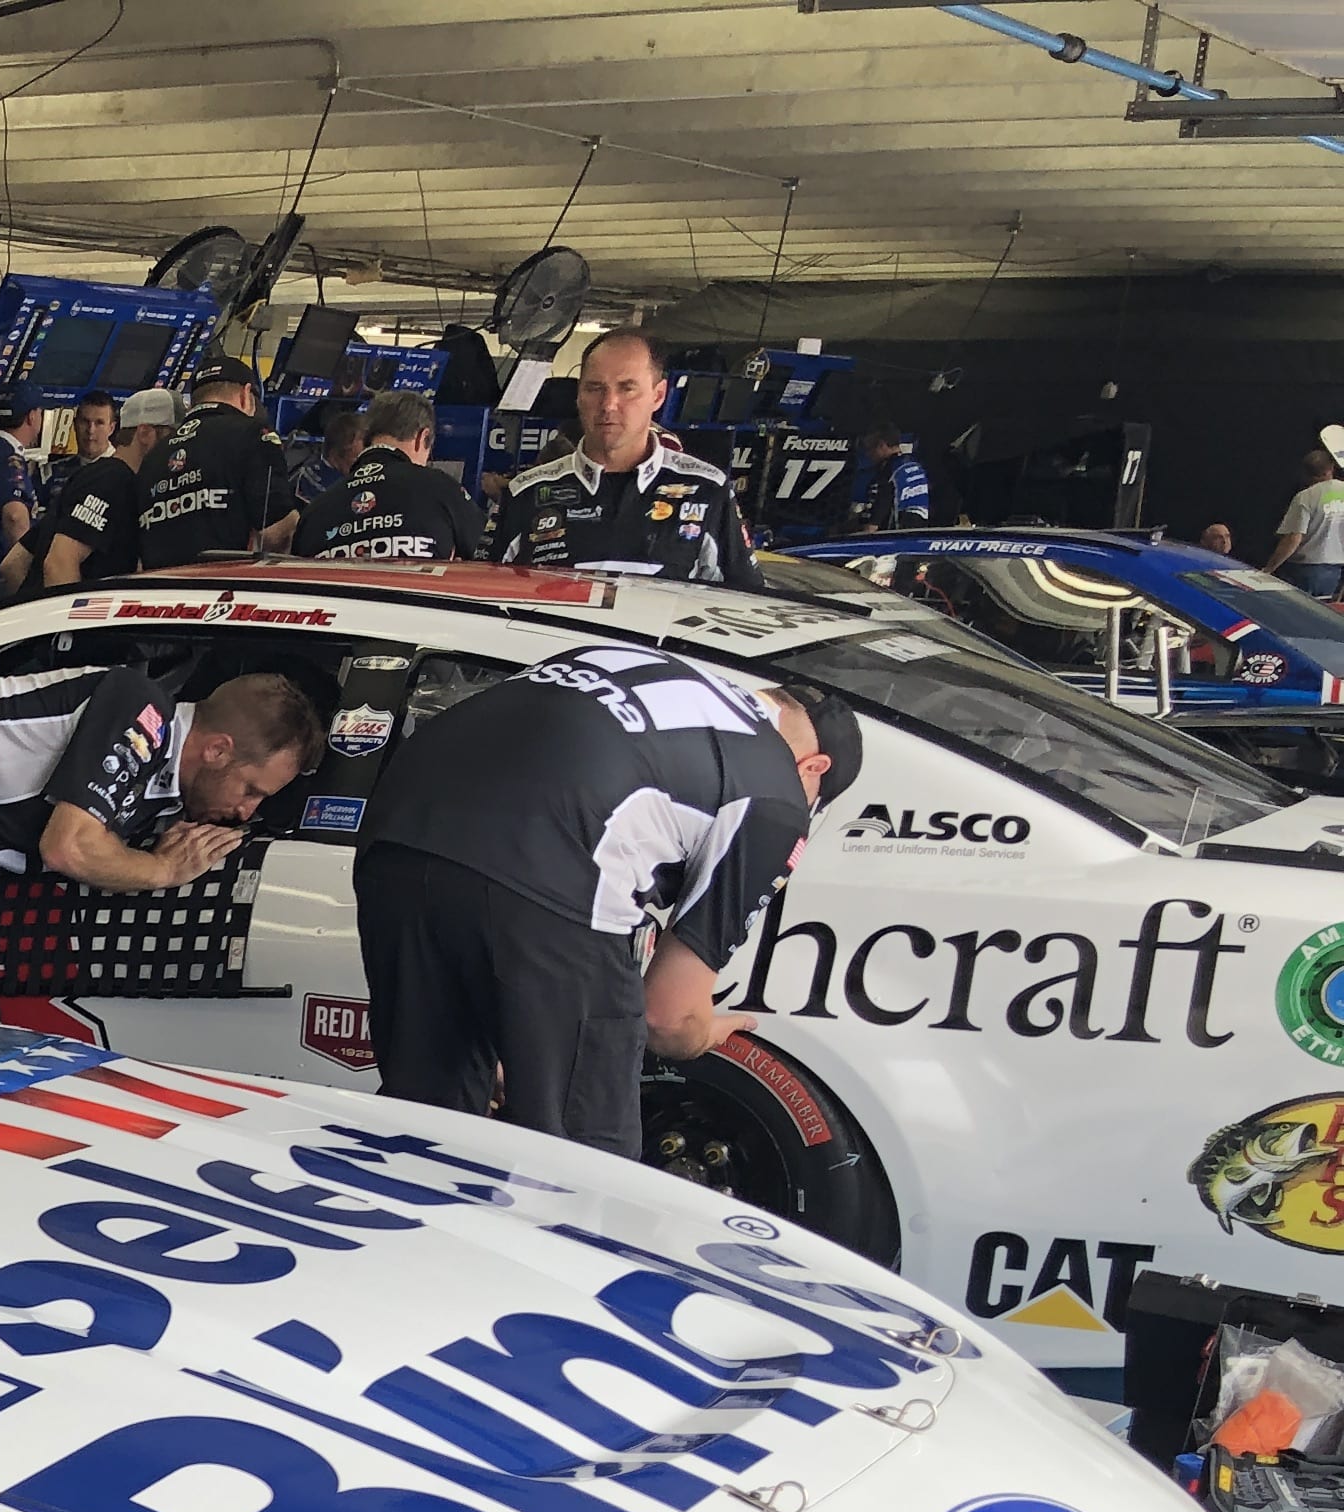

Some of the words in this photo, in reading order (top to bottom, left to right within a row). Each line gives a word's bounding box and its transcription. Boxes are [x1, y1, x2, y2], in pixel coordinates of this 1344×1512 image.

[782, 435, 849, 452] FASTENAL
[347, 473, 386, 489] TOYOTA
[775, 459, 846, 500] 17
[83, 493, 110, 515] GRIT
[679, 501, 709, 521] CAT
[70, 503, 109, 532] HOUSE
[338, 514, 404, 537] @LFR95
[536, 516, 558, 531] 50
[928, 540, 974, 552] RYAN
[975, 540, 1048, 556] PREECE
[113, 599, 213, 620] Daniel
[226, 603, 337, 627] Hemric
[337, 721, 388, 735] LUCAS
[838, 803, 1031, 845] ALSCO
[842, 842, 870, 853] Linen
[873, 843, 894, 854] and
[896, 844, 938, 856] Uniform
[941, 846, 976, 857] Rental
[978, 848, 1026, 860] Services
[712, 885, 1246, 1049] hcraft
[313, 1005, 355, 1039] RED
[743, 1048, 825, 1142] REMEMBER
[964, 1231, 1156, 1333] CAT
